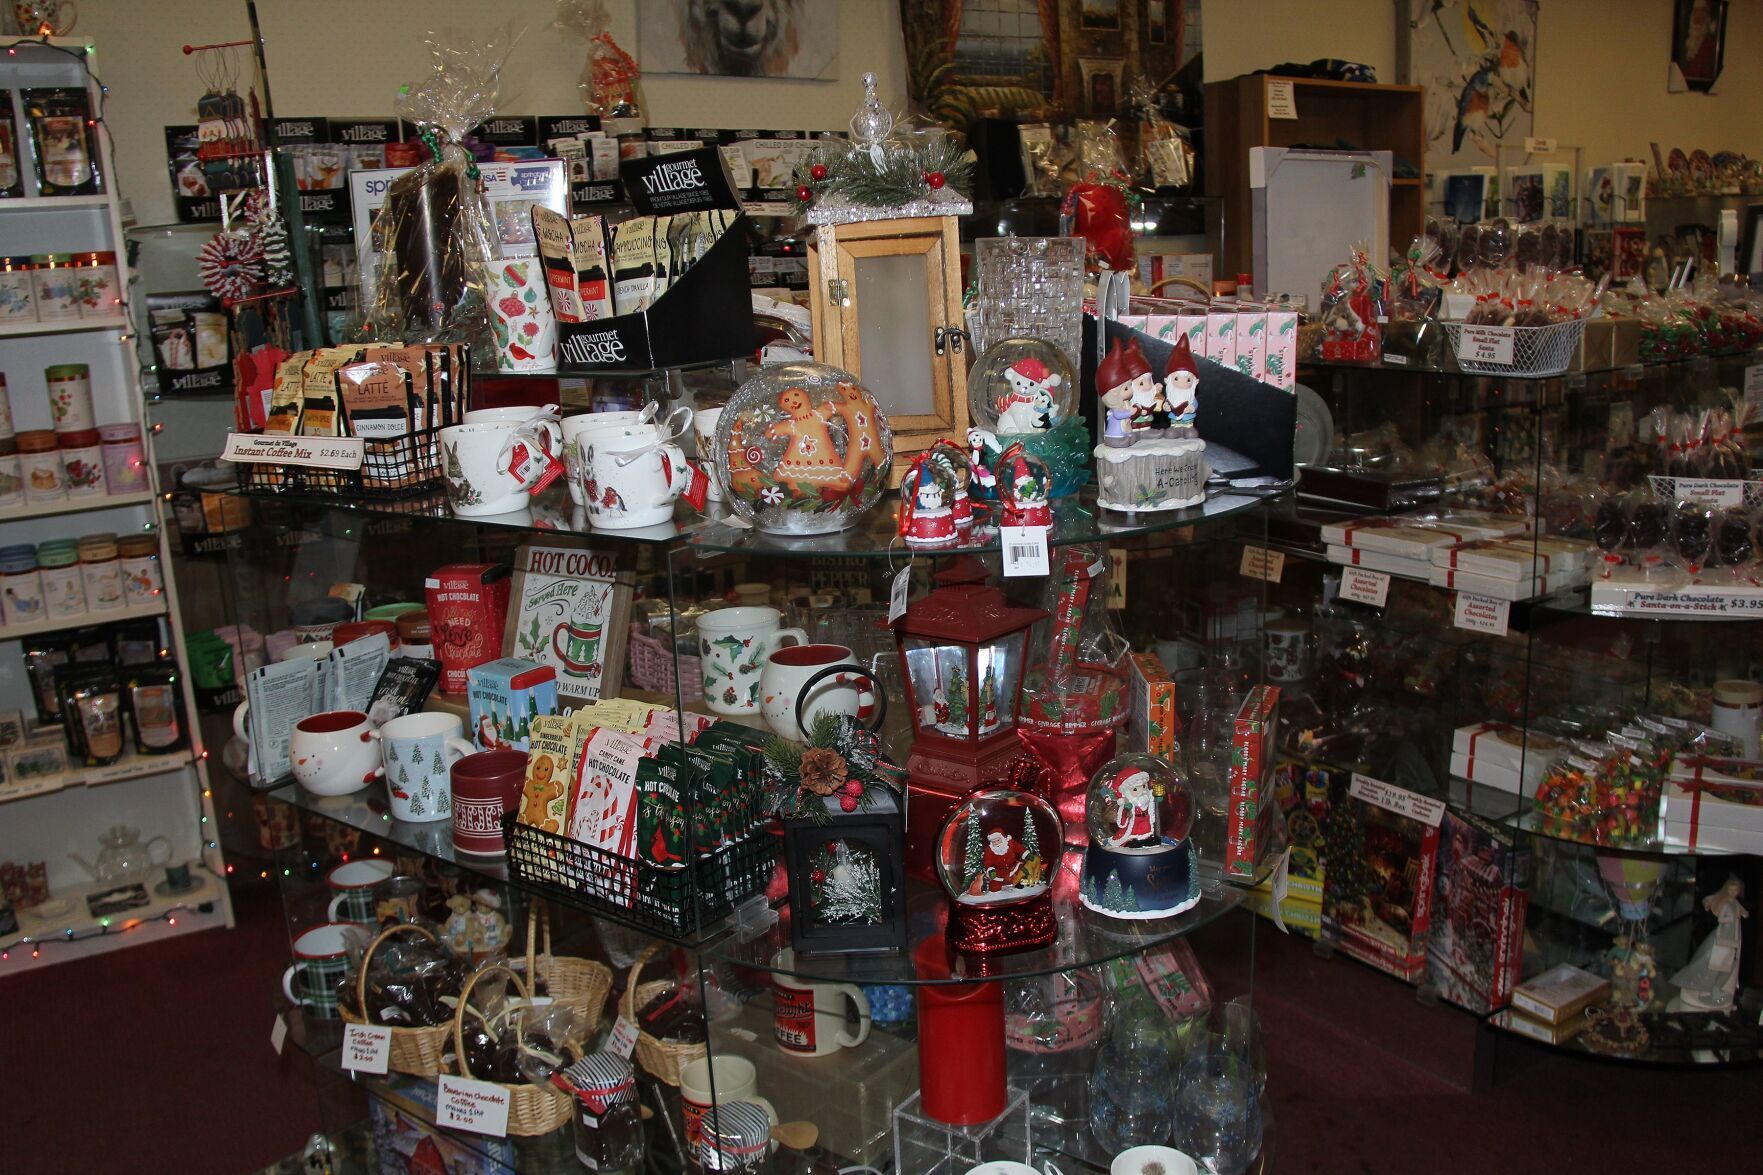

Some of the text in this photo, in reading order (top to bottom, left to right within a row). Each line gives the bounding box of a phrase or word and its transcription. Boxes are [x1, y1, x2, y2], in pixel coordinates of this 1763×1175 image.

[341, 125, 388, 141] village
[483, 120, 525, 133] village
[550, 120, 590, 133] village
[666, 158, 698, 173] gourmet
[641, 164, 706, 193] village
[366, 177, 392, 196] spri
[572, 186, 615, 201] village
[300, 194, 335, 211] llage
[542, 228, 563, 243] MOCHA
[581, 329, 619, 346] gourmet
[560, 334, 627, 363] village
[356, 423, 386, 431] CINNAMON
[282, 440, 297, 448] Village
[234, 445, 312, 458] Instant Coffee Mix
[320, 449, 356, 458] $2.69 Each
[1155, 467, 1172, 475] Here
[530, 551, 565, 573] HOT
[443, 580, 469, 590] village
[437, 593, 480, 602] HOT CHOCOLATE
[529, 584, 578, 608] Served Here
[1634, 592, 1724, 603] Pure Dark Chocolate
[1467, 602, 1496, 612] Assorted
[1640, 601, 1717, 610] Santa-on-a-Stick
[1731, 599, 1763, 609] $3.95
[1464, 608, 1498, 620] Chocolates
[448, 617, 471, 627] NEED
[561, 683, 600, 697] WARM UP
[472, 691, 508, 705] HOT CHOCOLATE
[530, 740, 567, 755] HOT CHOCOLATE
[604, 738, 633, 754] village
[614, 756, 626, 766] CANE
[588, 758, 631, 784] HOT CHOCOLATE
[644, 781, 657, 792] HOT
[1416, 853, 1430, 918] springbok
[451, 1097, 476, 1108] Coffee
[474, 1091, 504, 1105] Chocolate
